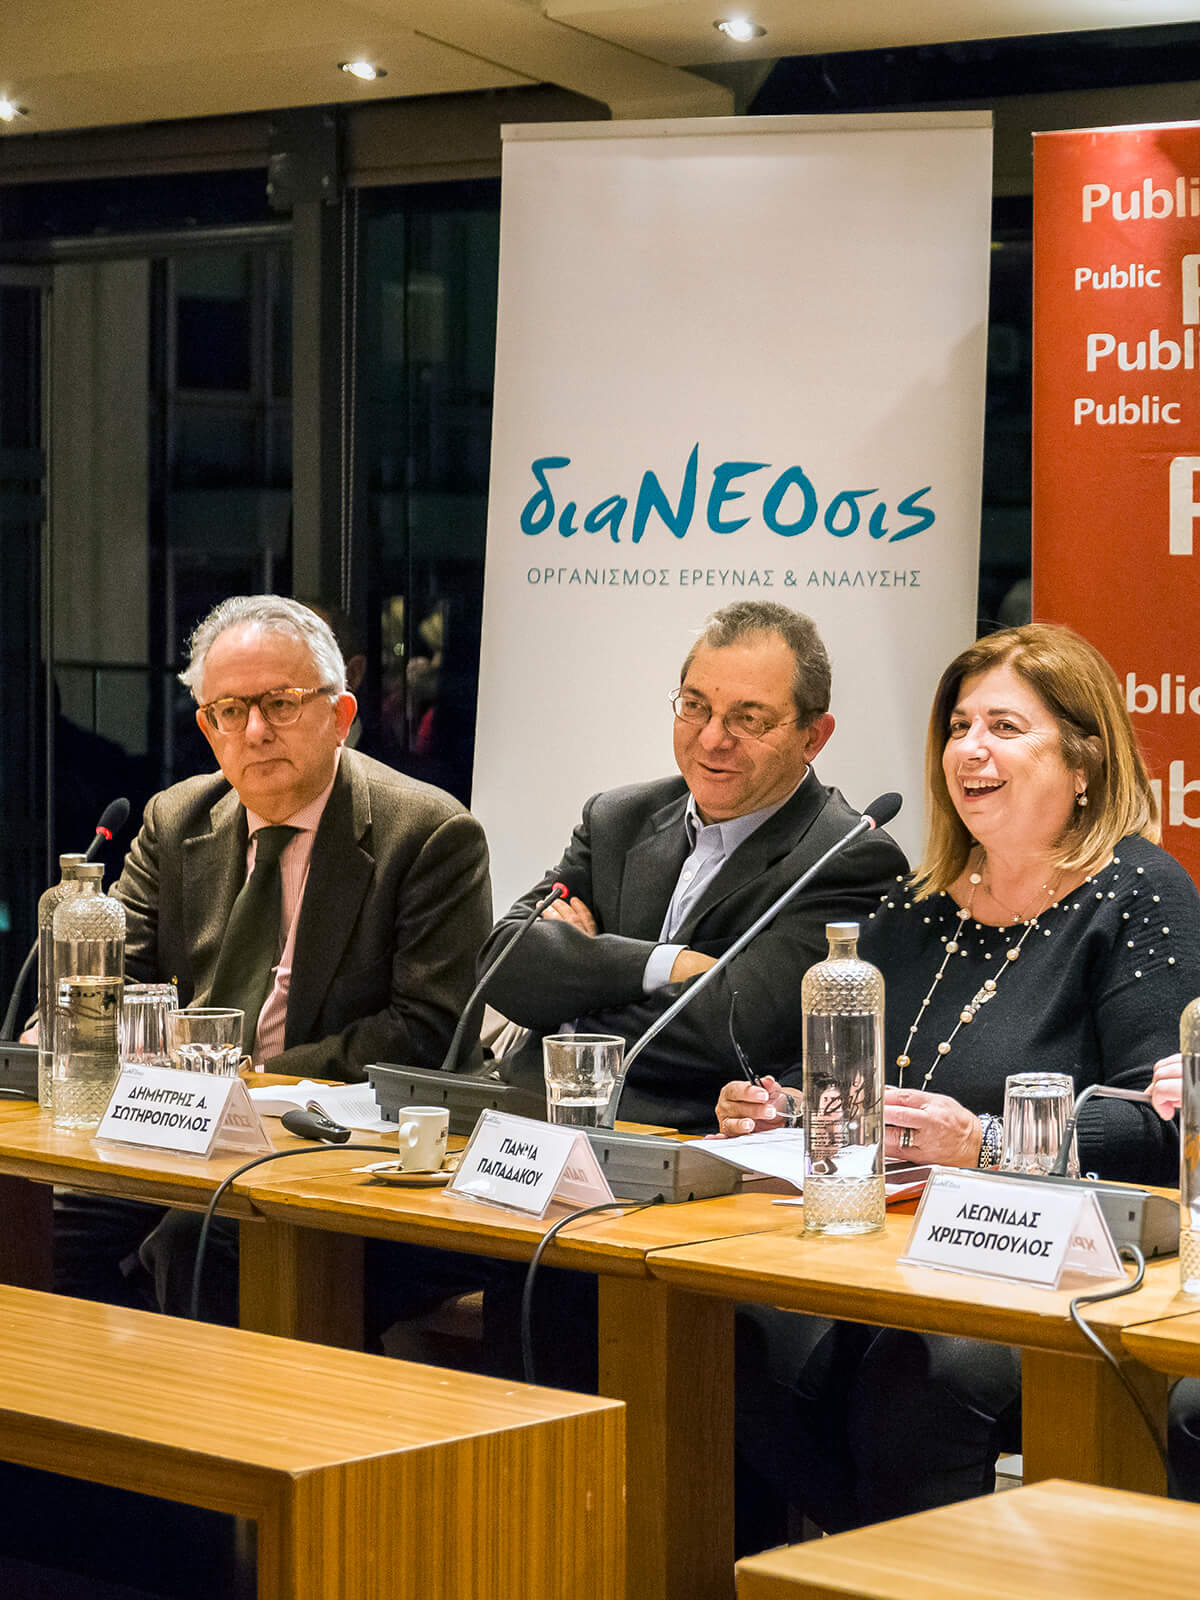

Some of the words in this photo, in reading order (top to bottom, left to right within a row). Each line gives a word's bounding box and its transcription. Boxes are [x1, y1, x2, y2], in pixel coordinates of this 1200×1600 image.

[1074, 263, 1162, 291] Public
[1073, 395, 1181, 426] Public
[527, 567, 670, 587] ΟΡΓΑΝΙΣΜΟΣ
[679, 569, 775, 587] ΕΡΕΥΝΑΣ
[783, 570, 797, 587] &
[807, 570, 922, 588] ΑΝΑΛΥΣΗΣ
[127, 1085, 193, 1108] ΔΗΜΗΤΡΗΣ
[110, 1104, 212, 1133] ΣΩΤΗΡΟΠΟΥΛΟΣ
[476, 1157, 544, 1188] ΠΑΠΑΔΑΚΟΥ
[956, 1203, 1042, 1229] ΛΕΩΝΙΔΑΣ
[927, 1225, 1054, 1258] ΧΡΙΣΤΟΠΟΥΛΟΣ
